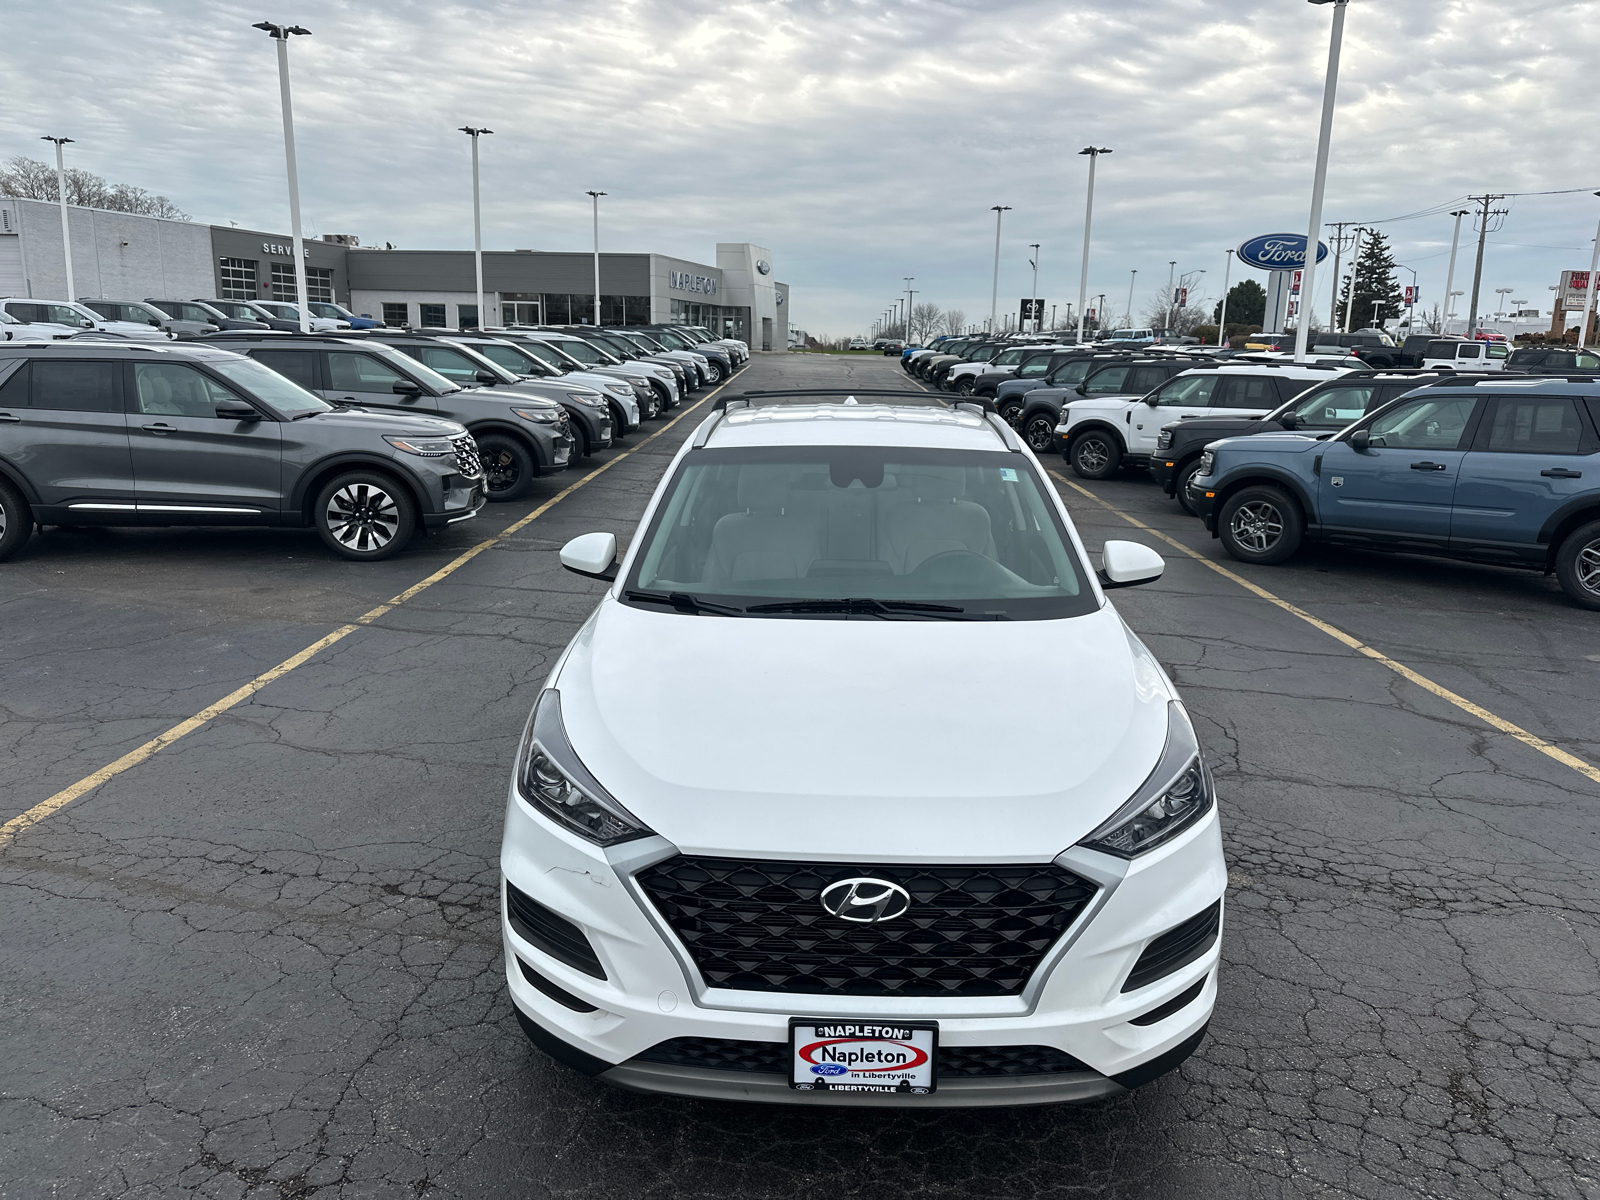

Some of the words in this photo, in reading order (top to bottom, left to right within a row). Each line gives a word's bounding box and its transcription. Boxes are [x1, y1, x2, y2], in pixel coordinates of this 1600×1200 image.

[263, 243, 309, 258] SERVE
[1570, 271, 1592, 281] FORU
[670, 270, 717, 295] NAPLETON
[1568, 280, 1591, 290] SQUA
[824, 1025, 904, 1040] NAPLETON
[821, 1046, 907, 1066] Napleton
[818, 1065, 841, 1075] Ford
[863, 1072, 917, 1080] Libertyville
[829, 1085, 897, 1093] LIBERTYVILLE
